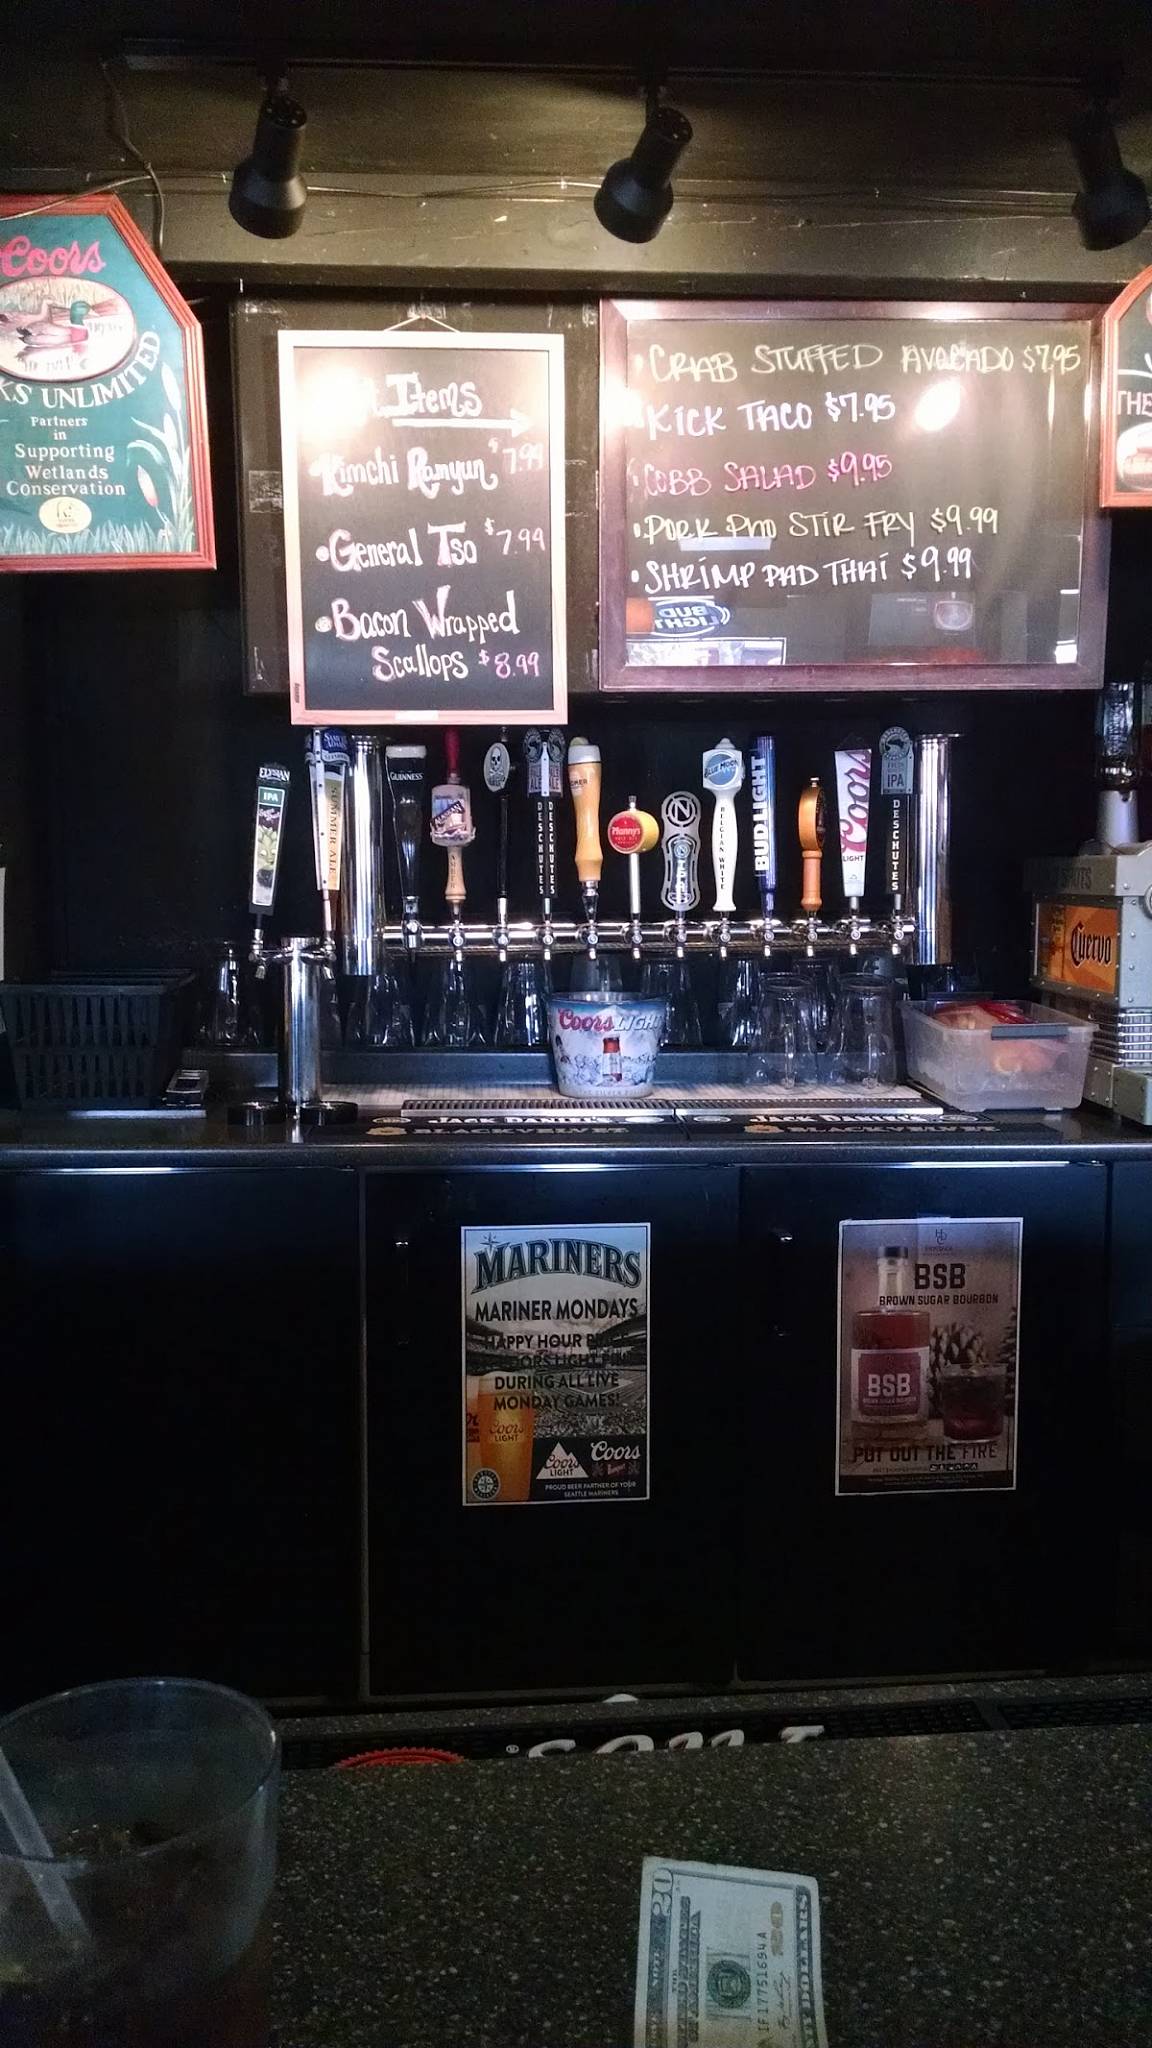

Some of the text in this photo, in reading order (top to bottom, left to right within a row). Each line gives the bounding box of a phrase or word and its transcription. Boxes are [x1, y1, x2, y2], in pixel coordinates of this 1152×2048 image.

[0, 236, 106, 277] Coors
[42, 330, 161, 408] UNLIMITED
[649, 344, 738, 383] CRAB
[751, 343, 883, 375] STUFFED
[902, 345, 1014, 374] AVOCADO
[31, 416, 88, 427] Partners
[646, 391, 895, 441] KICK TACO $7.95
[53, 429, 67, 441] in
[15, 443, 115, 463] Supporting
[25, 465, 109, 480] Wetlands
[318, 446, 400, 497] Kimchi
[644, 451, 893, 497] COBB SALAD $9.95
[6, 482, 126, 496] Conservation
[643, 514, 718, 545] PORK
[789, 511, 855, 537] STIR
[864, 510, 915, 548] FRY
[930, 504, 999, 536] $9.99
[328, 517, 545, 573] General Tso $7.99
[644, 545, 972, 594] SHRIMP PAD THAI $9.99
[330, 584, 520, 645] Bacon Wrapped
[371, 644, 540, 681] Scallops $8.99
[390, 772, 424, 781] GUINNESS
[888, 774, 904, 787] IPA
[263, 791, 279, 802] IPA
[840, 749, 871, 853] Coors
[329, 787, 337, 844] SUMMER
[751, 756, 769, 871] BUD LIGHT
[892, 800, 900, 890] DESCHUTES
[1071, 921, 1112, 968] Cuervo
[558, 1008, 615, 1031] Coors
[428, 1116, 496, 1124] JACK
[749, 1114, 816, 1122] JACK
[471, 1238, 642, 1294] MARINERS
[914, 1263, 966, 1290] BSB
[475, 1298, 638, 1321] MARINER MONDAYS
[879, 1294, 999, 1306] BROWN SUGAR BOURBON
[485, 1335, 533, 1350] HAPPY
[538, 1334, 582, 1348] HOUR
[495, 1374, 619, 1390] DURING ALL LIVE
[868, 1373, 911, 1397] BSB
[493, 1394, 620, 1411] MONDAY GAMES!
[489, 1421, 524, 1435] Coors
[495, 1434, 519, 1442] LIGHT
[590, 1440, 642, 1461] Coors
[852, 1443, 998, 1463] PUT OUT THE FIRE
[544, 1455, 579, 1470] Coors
[550, 1469, 574, 1477] LIGHT
[652, 1868, 673, 1916] 20
[800, 1894, 811, 2008] DOLLARS
